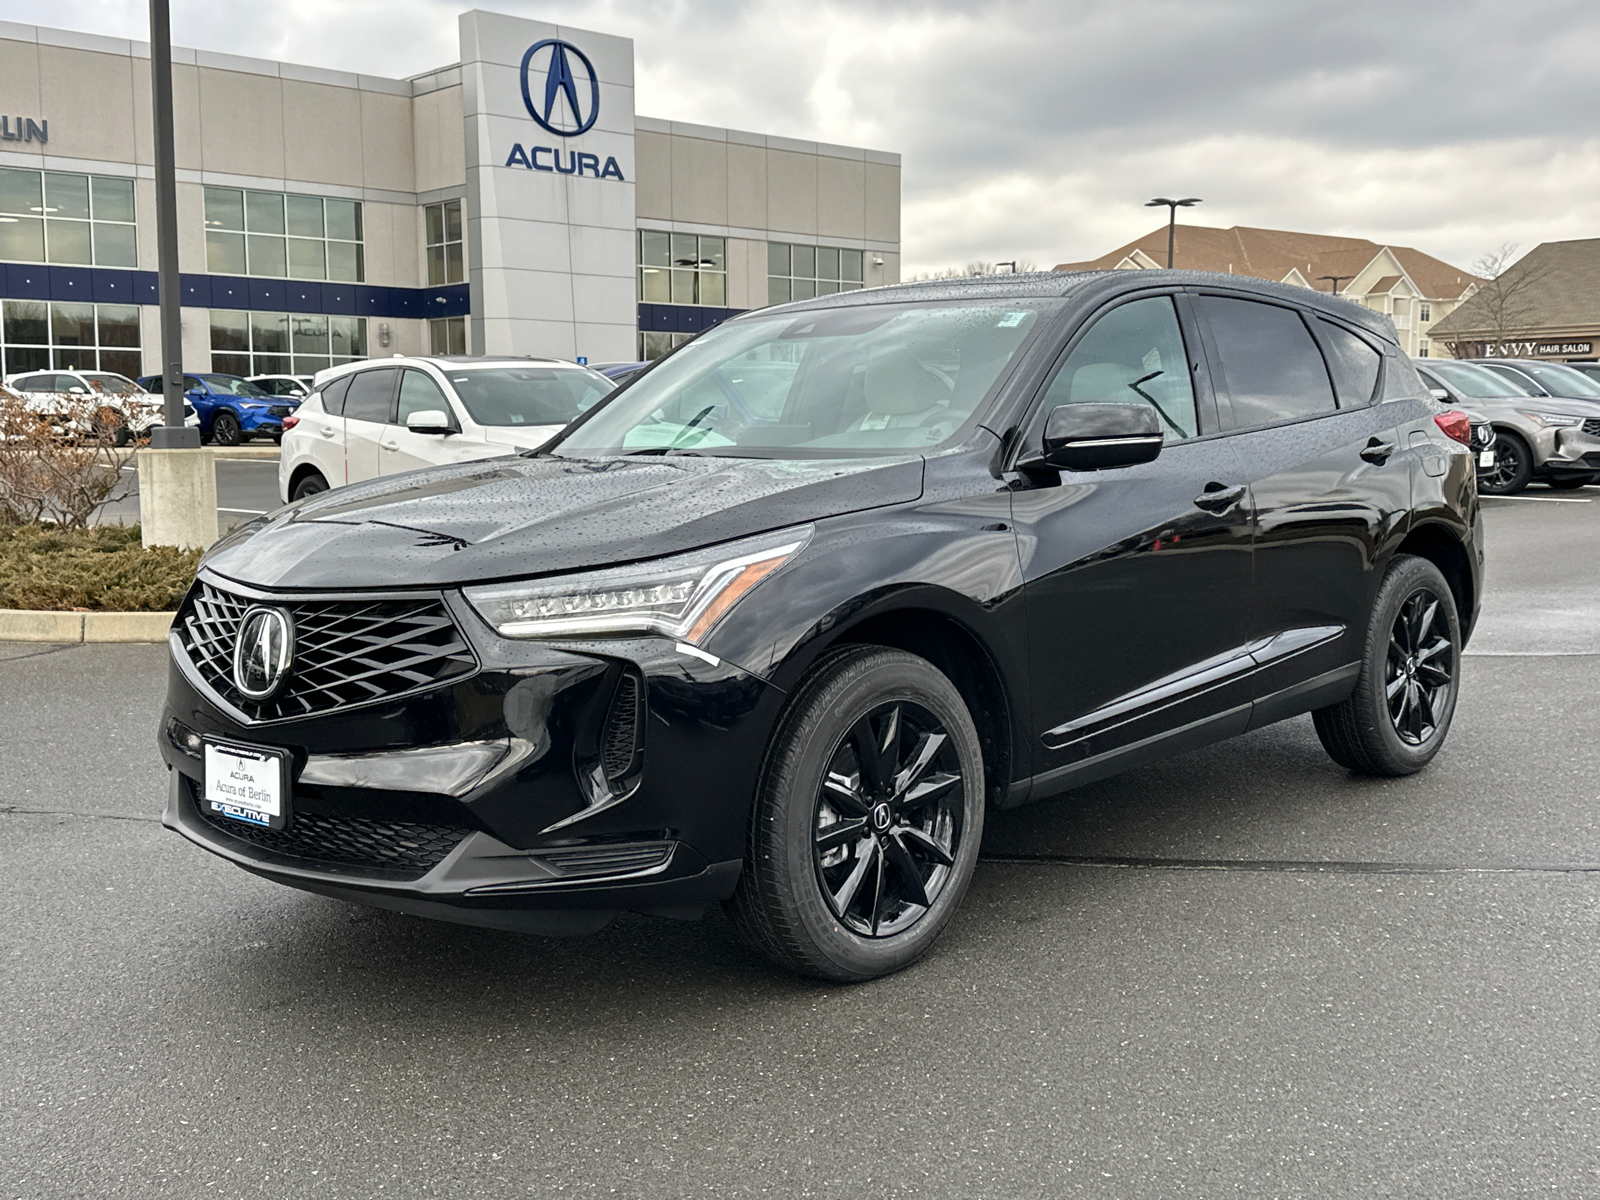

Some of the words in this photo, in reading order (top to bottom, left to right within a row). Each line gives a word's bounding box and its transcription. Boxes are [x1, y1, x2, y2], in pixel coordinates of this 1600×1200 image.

[1, 115, 48, 143] LIN
[505, 143, 625, 181] ACURA
[1484, 342, 1537, 358] ENVY
[1540, 345, 1560, 354] HAIR
[1562, 343, 1590, 353] SALON
[229, 771, 255, 783] ACURA
[215, 779, 237, 796] Acura
[238, 786, 246, 798] of
[248, 786, 272, 803] Berlin
[211, 801, 270, 824] EXECUTIVE
